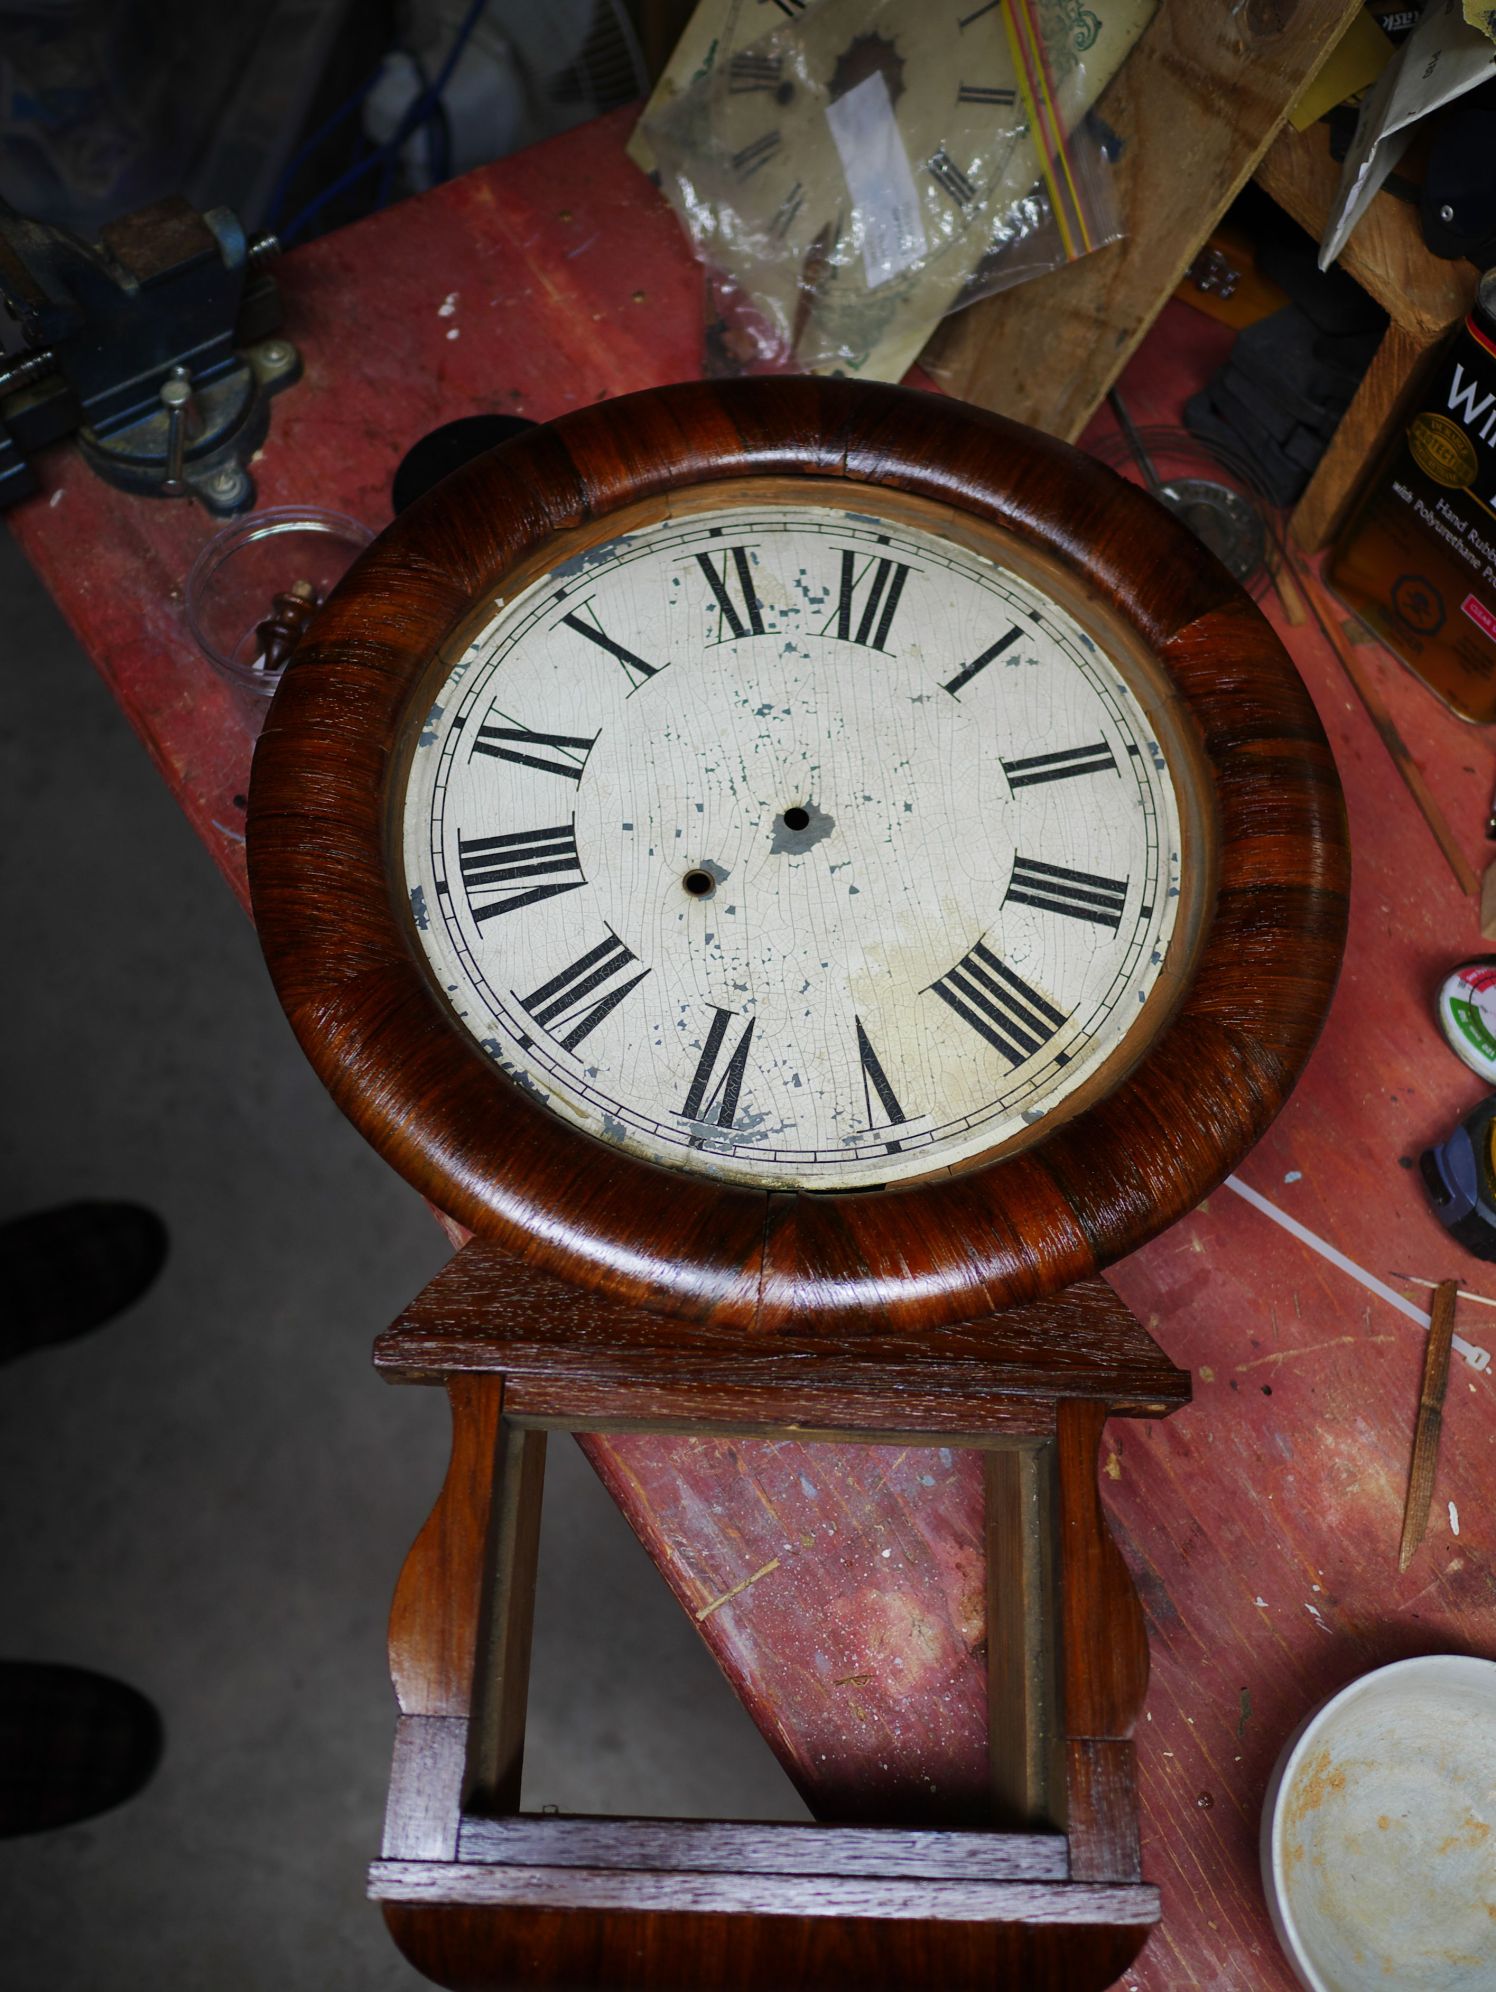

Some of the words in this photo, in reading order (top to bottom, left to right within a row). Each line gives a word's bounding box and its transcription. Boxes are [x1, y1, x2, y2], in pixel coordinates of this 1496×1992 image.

[1414, 499, 1481, 570] Polyurethane
[1435, 498, 1468, 532] Hand
[1467, 527, 1496, 566] Rubb
[549, 594, 671, 699] X
[673, 544, 782, 648] XI
[806, 547, 924, 657] XII
[936, 618, 1035, 703] I
[467, 695, 603, 792] IX
[999, 729, 1122, 799] II
[457, 811, 588, 940] VIII
[999, 848, 1130, 940] III
[510, 920, 652, 1064] VII
[918, 932, 1081, 1077] IIII
[669, 1003, 756, 1130] VI
[853, 1014, 927, 1133] V
